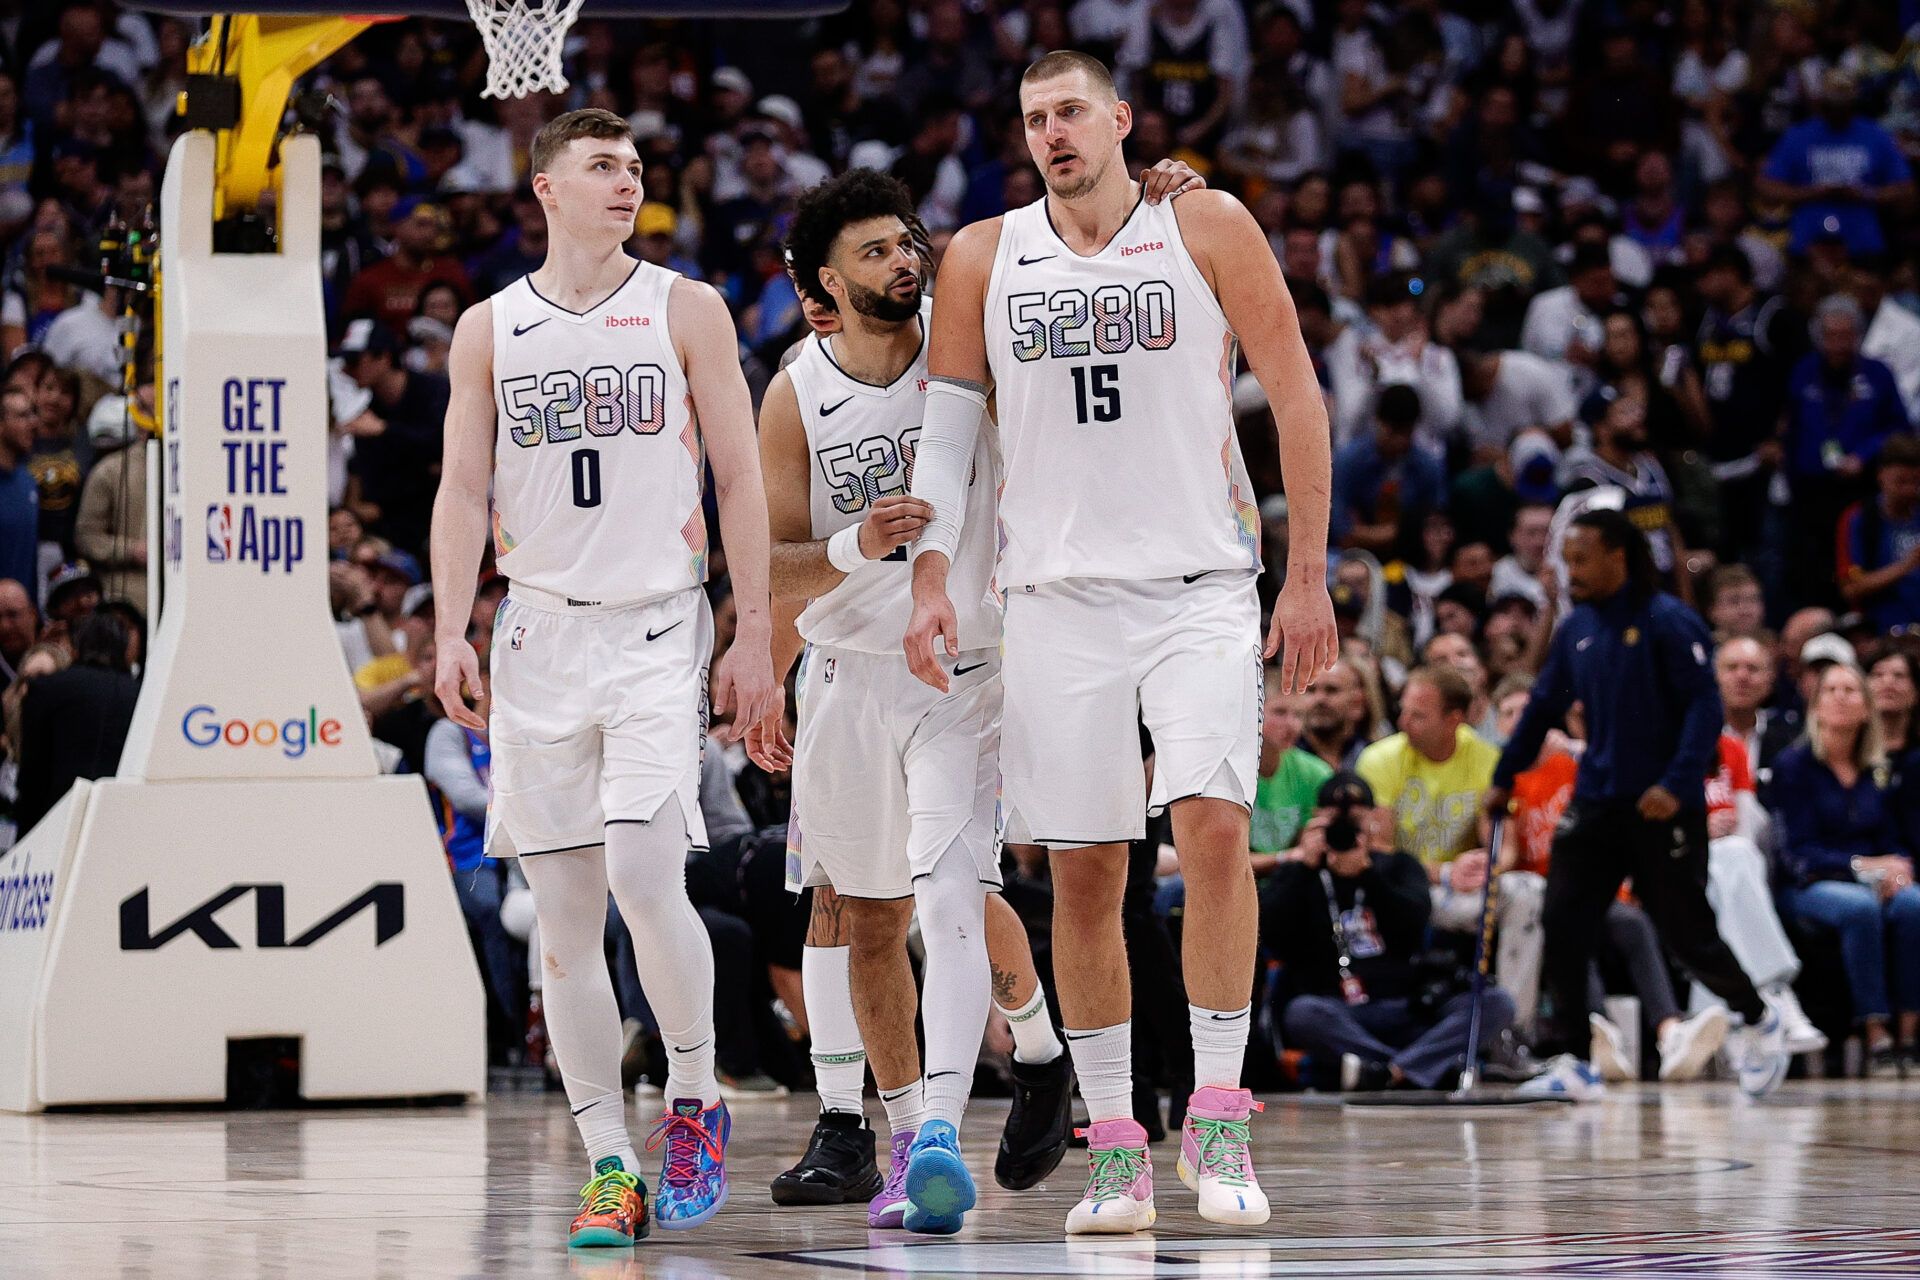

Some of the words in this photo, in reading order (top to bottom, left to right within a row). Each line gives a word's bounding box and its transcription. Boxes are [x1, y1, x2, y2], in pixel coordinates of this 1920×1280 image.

[1120, 240, 1164, 257] ibotta
[605, 315, 650, 328] ibotta
[1007, 279, 1177, 363] 5280
[223, 378, 286, 432] GET
[500, 363, 667, 448] 5280
[1070, 364, 1121, 424] 15
[222, 442, 288, 495] THE
[571, 448, 602, 508] 0
[238, 504, 304, 573] App
[182, 704, 342, 758] Google
[120, 883, 404, 950] KIA
